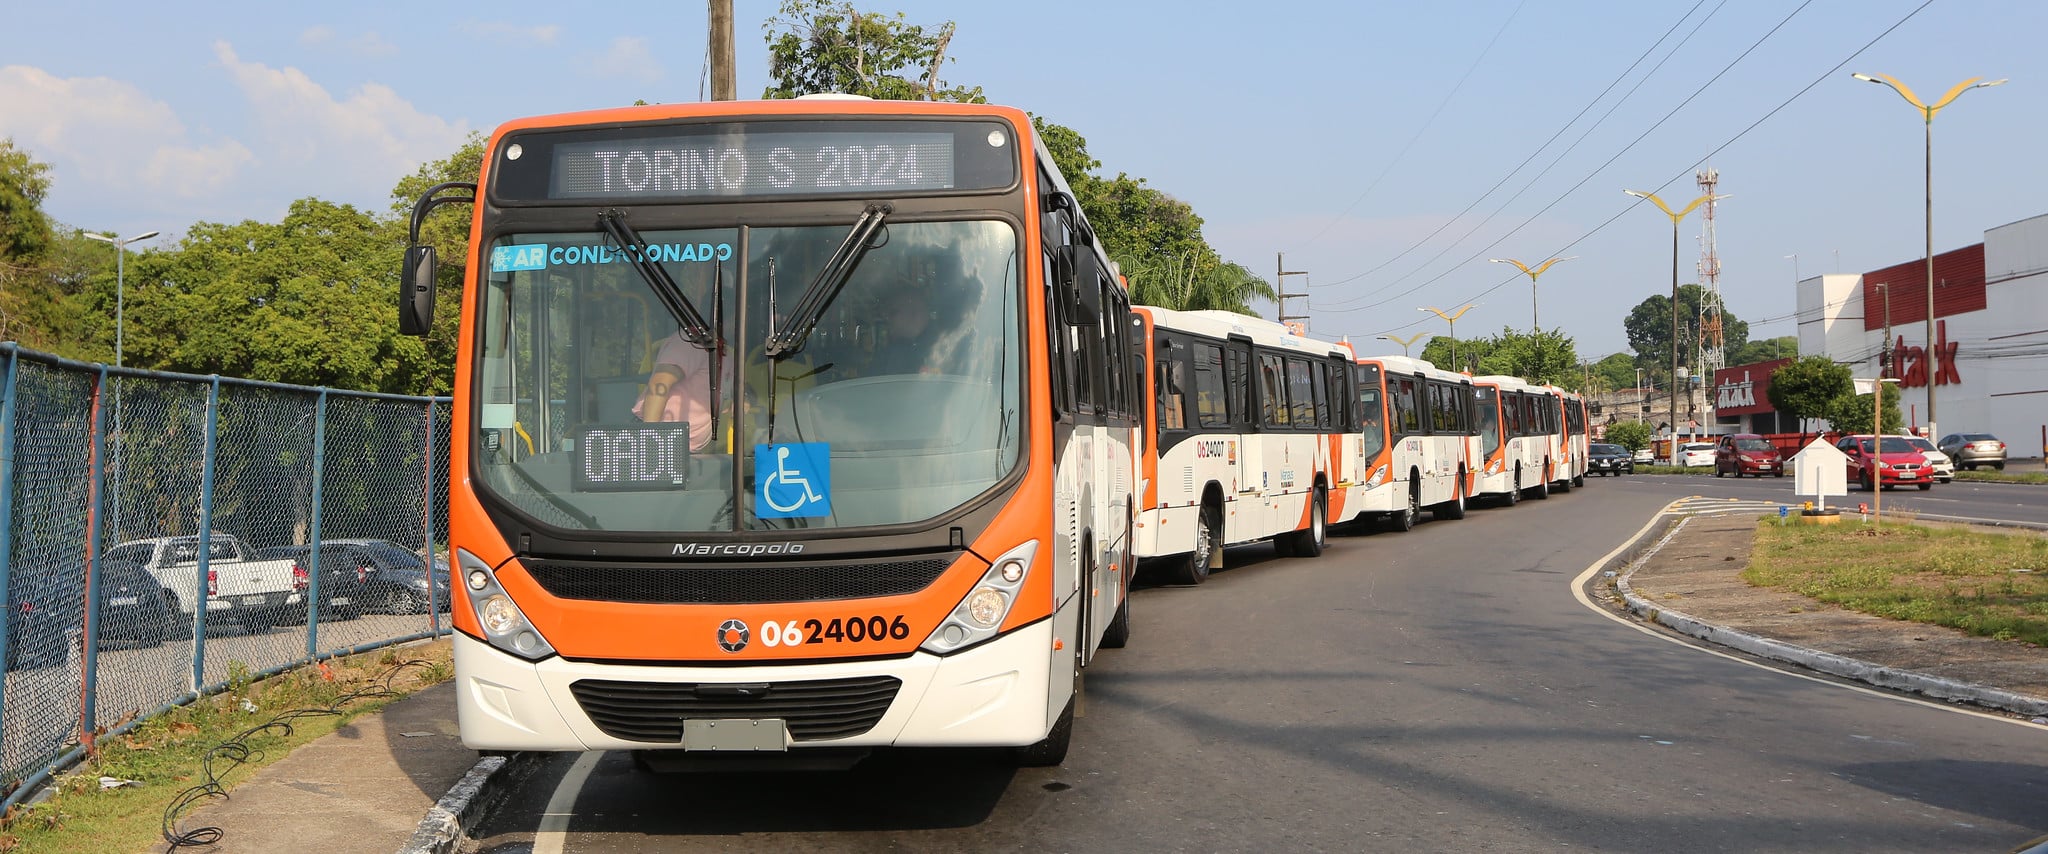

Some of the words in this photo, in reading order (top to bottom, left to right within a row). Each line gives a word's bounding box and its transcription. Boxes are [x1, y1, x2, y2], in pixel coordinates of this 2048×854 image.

[594, 147, 747, 192] TORINO
[768, 146, 796, 188] S
[816, 144, 923, 187] 2024
[513, 247, 545, 268] AR
[1197, 440, 1225, 459] 0624007
[671, 541, 805, 557] Marcopolo
[760, 614, 910, 647] 0624006
